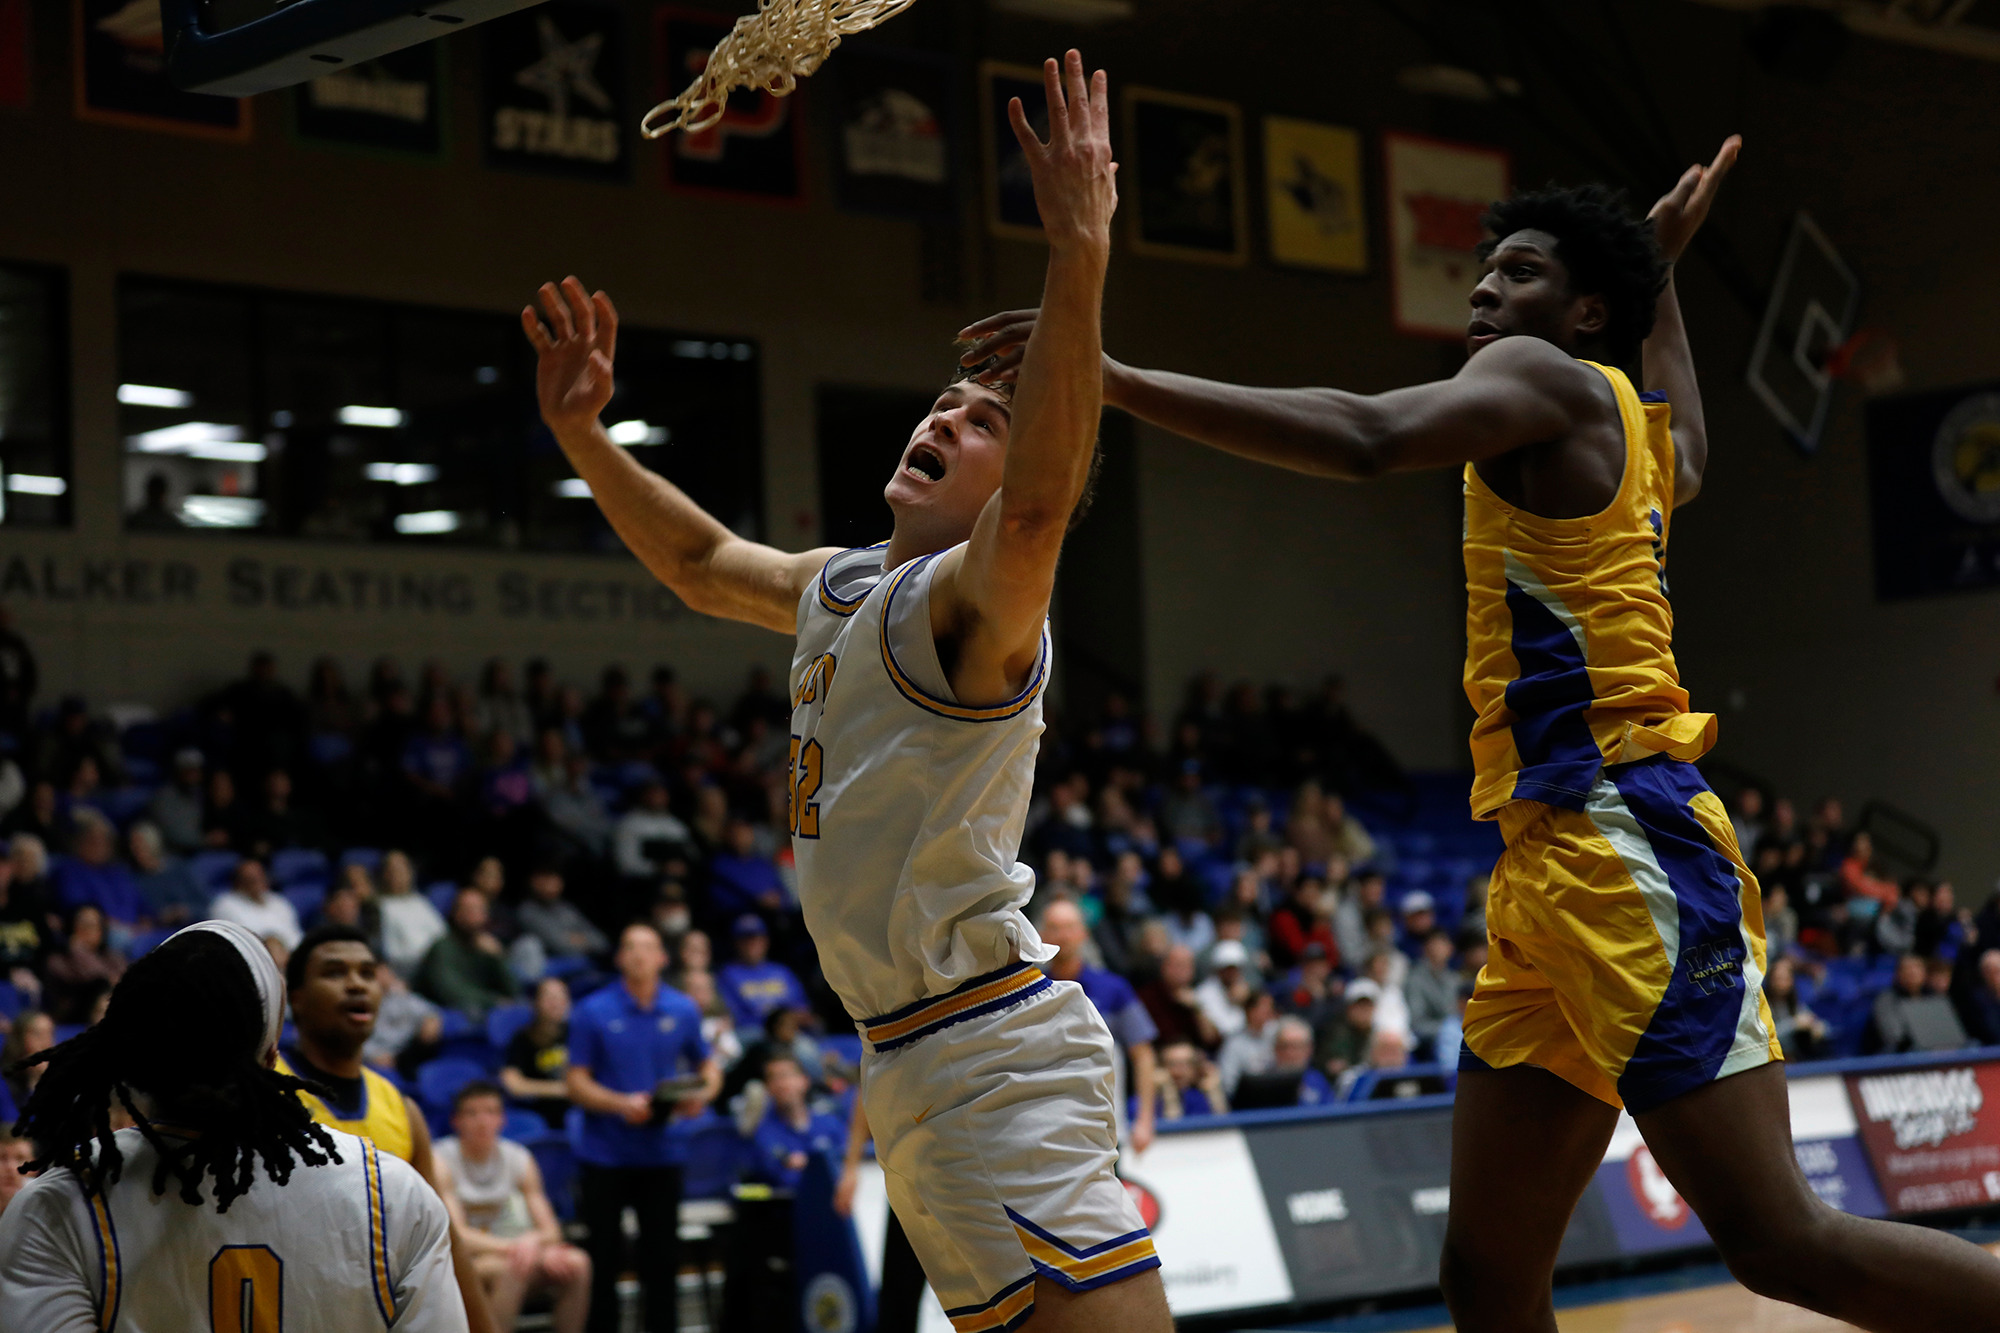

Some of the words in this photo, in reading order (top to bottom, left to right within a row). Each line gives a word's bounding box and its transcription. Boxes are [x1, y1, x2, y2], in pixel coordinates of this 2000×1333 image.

[494, 106, 619, 164] STARS
[227, 556, 473, 618] SEATING
[500, 568, 694, 622] SECTIO
[1693, 961, 1734, 979] WAYLAND
[208, 1244, 284, 1333] 0
